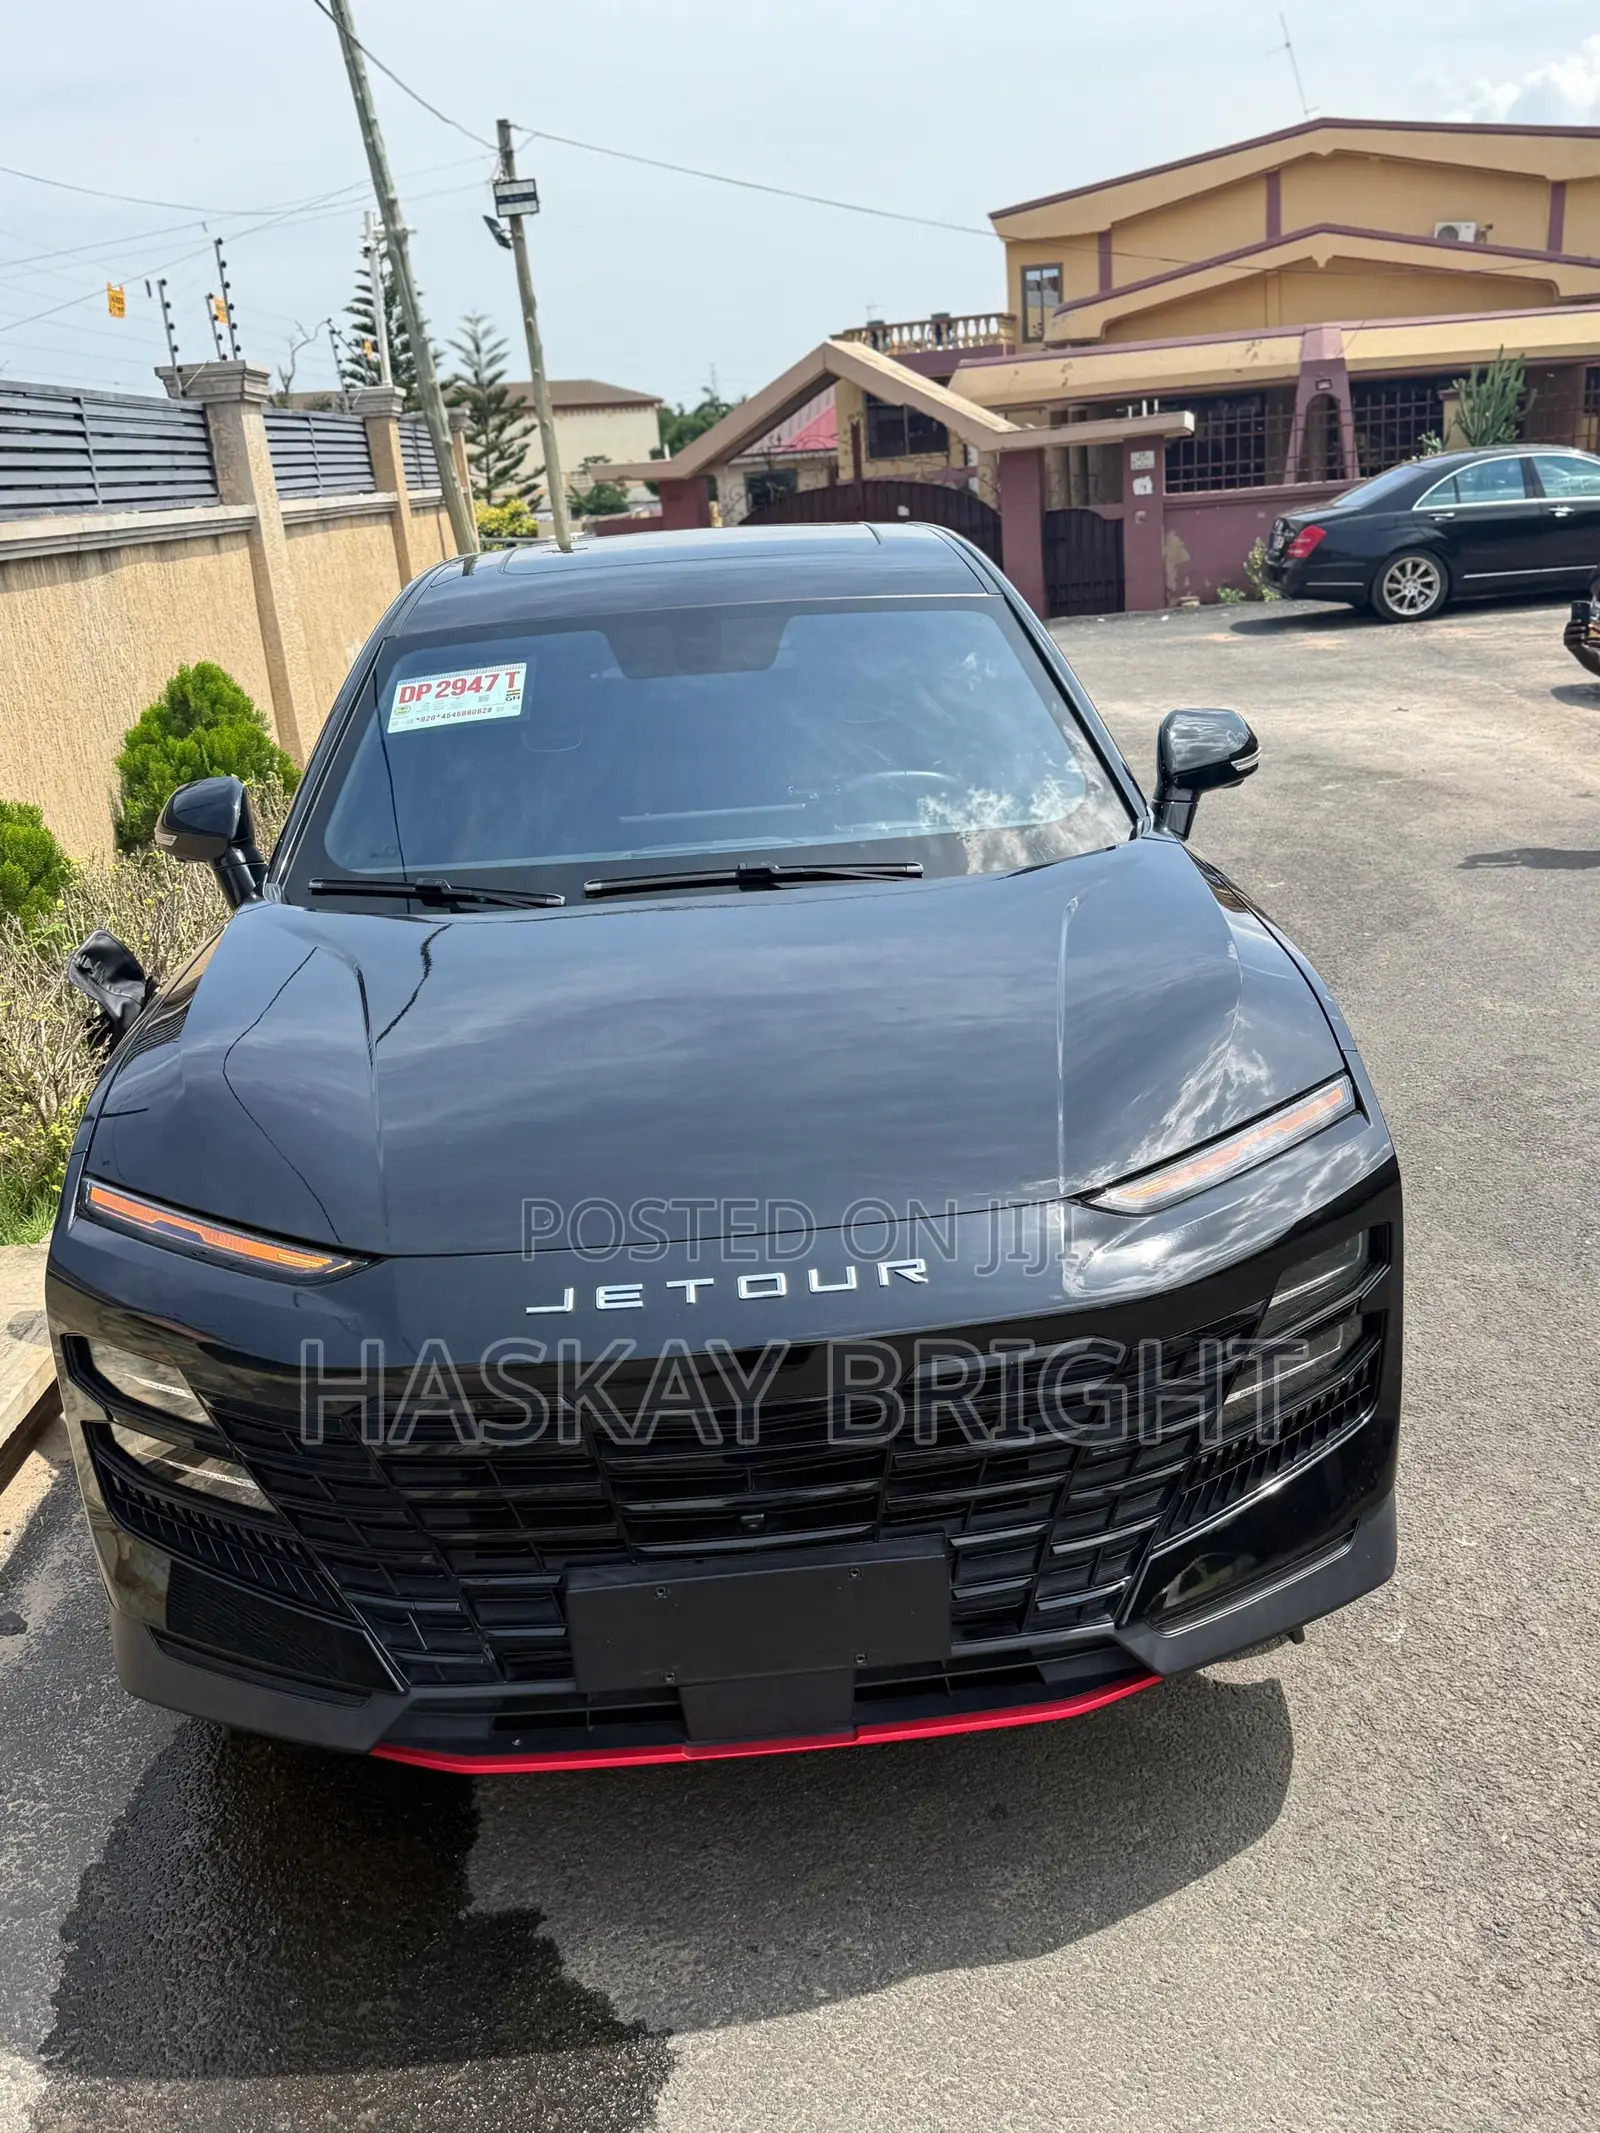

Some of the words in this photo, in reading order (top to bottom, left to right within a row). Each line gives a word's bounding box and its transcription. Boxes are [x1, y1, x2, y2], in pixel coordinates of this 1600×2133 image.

[398, 683, 432, 704] DP
[434, 674, 499, 699] 2947
[505, 671, 521, 689] T
[505, 694, 521, 702] GH
[526, 1258, 929, 1314] JETOUR
